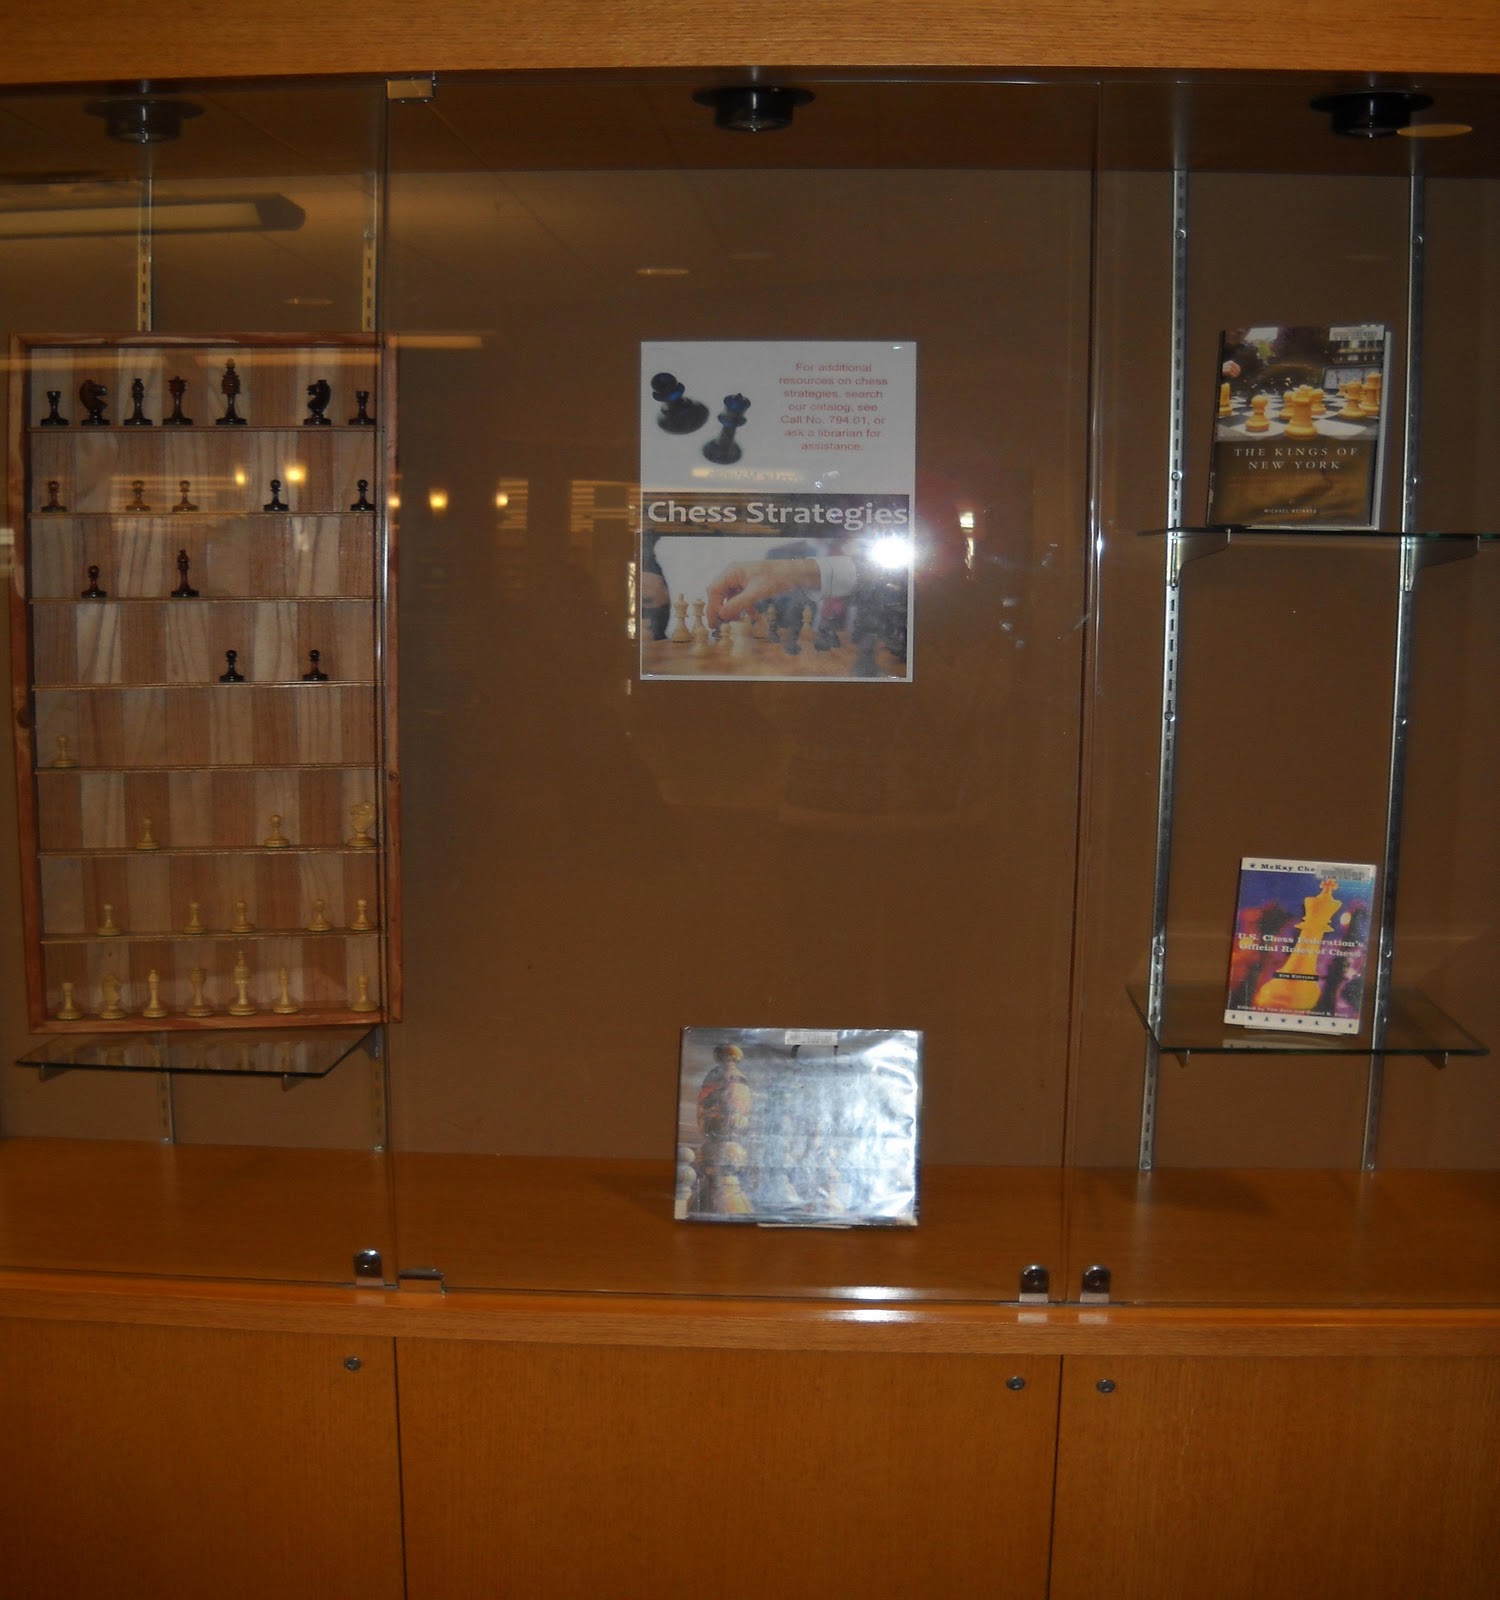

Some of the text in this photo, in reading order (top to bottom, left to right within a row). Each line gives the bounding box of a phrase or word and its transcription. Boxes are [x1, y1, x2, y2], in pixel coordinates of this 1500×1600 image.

[795, 363, 872, 372] For additional
[779, 377, 834, 385] resources
[855, 377, 888, 385] chess
[780, 416, 802, 424] Call
[818, 429, 863, 437] librarian
[866, 429, 881, 437] for
[1234, 447, 1359, 457] THE KINGS OF
[648, 501, 908, 531] Chess Strategies
[1260, 864, 1293, 872] McKay
[1238, 932, 1259, 941] U.S.
[1262, 934, 1294, 943] Chess
[1239, 943, 1278, 952] Official
[1329, 948, 1361, 957] Chess
